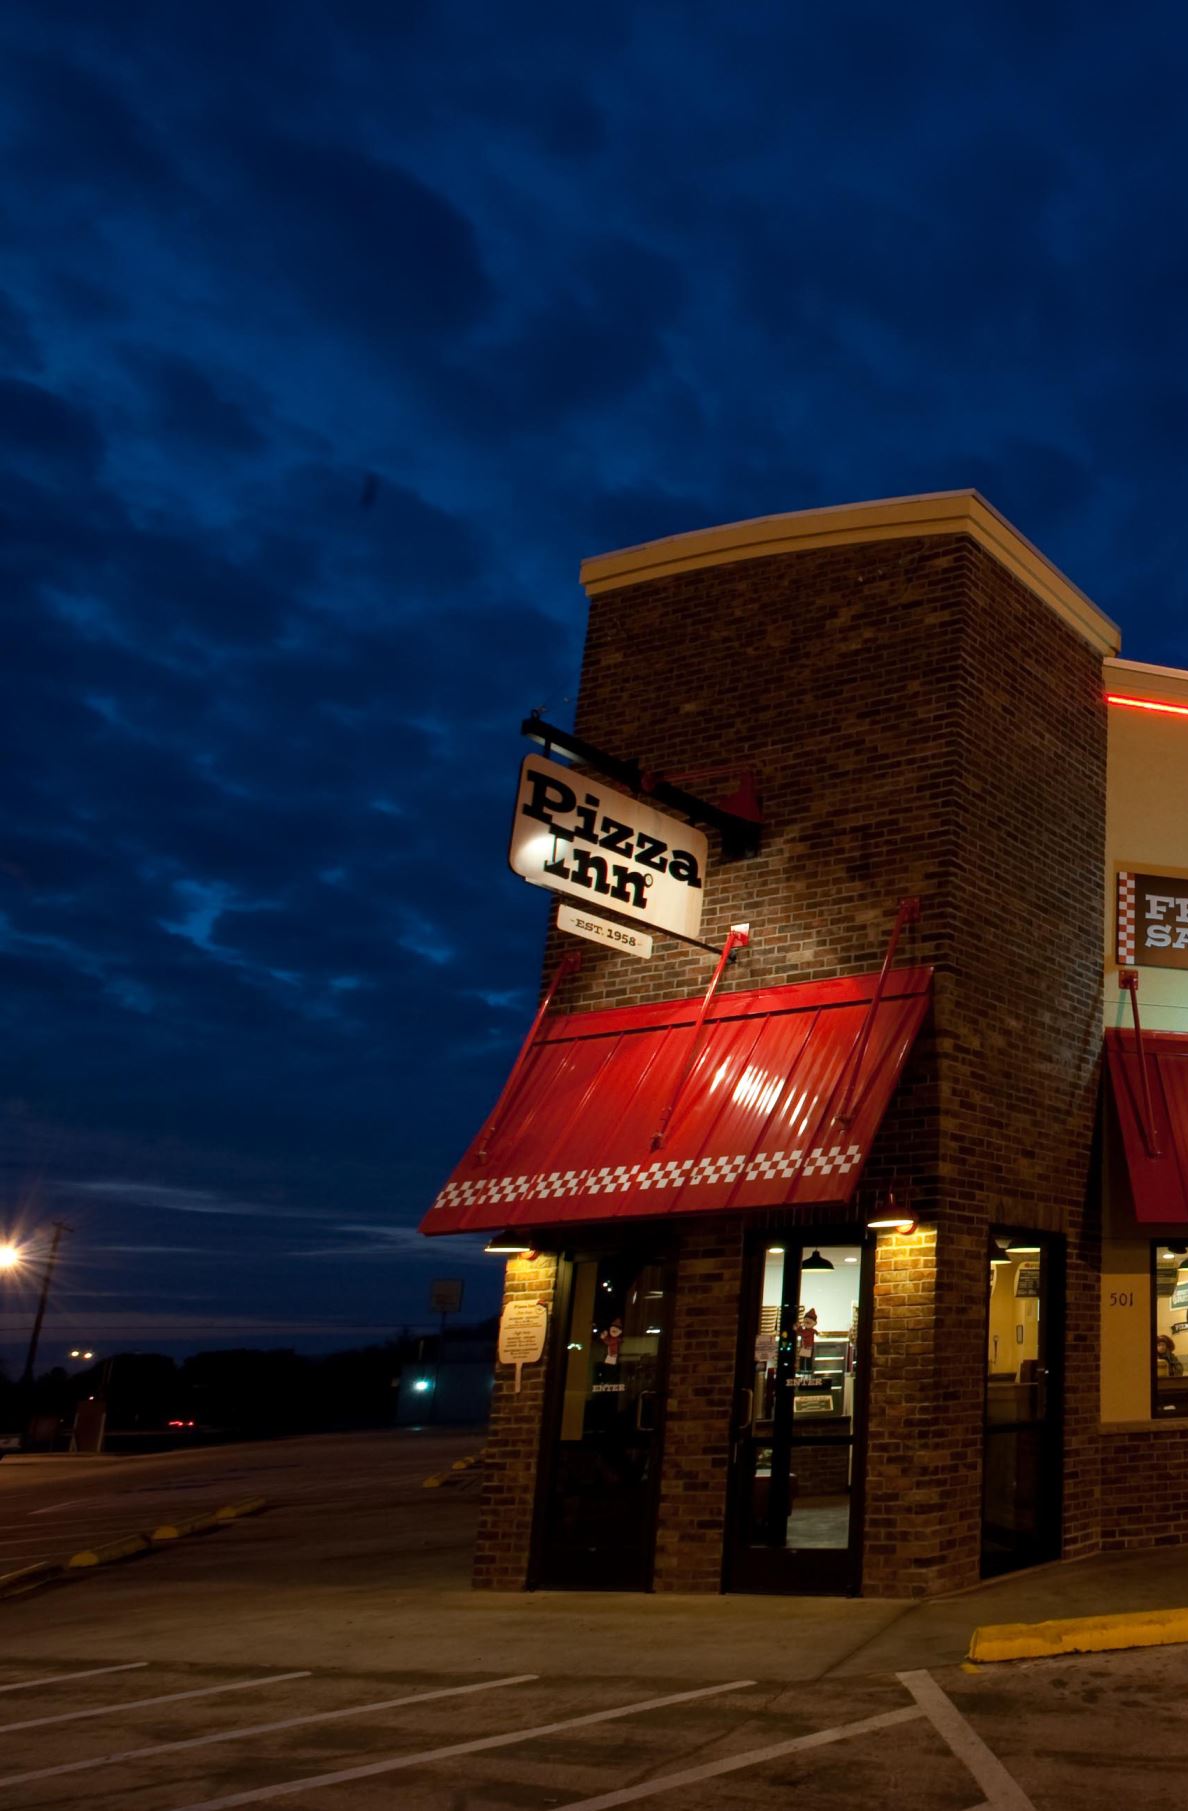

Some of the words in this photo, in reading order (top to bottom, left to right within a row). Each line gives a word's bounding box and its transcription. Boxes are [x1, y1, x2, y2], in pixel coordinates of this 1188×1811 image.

[522, 769, 702, 888] Pizza
[543, 829, 649, 909] Inn
[606, 928, 637, 947] 1958
[1110, 1292, 1133, 1307] 501
[786, 1378, 823, 1387] ENTER
